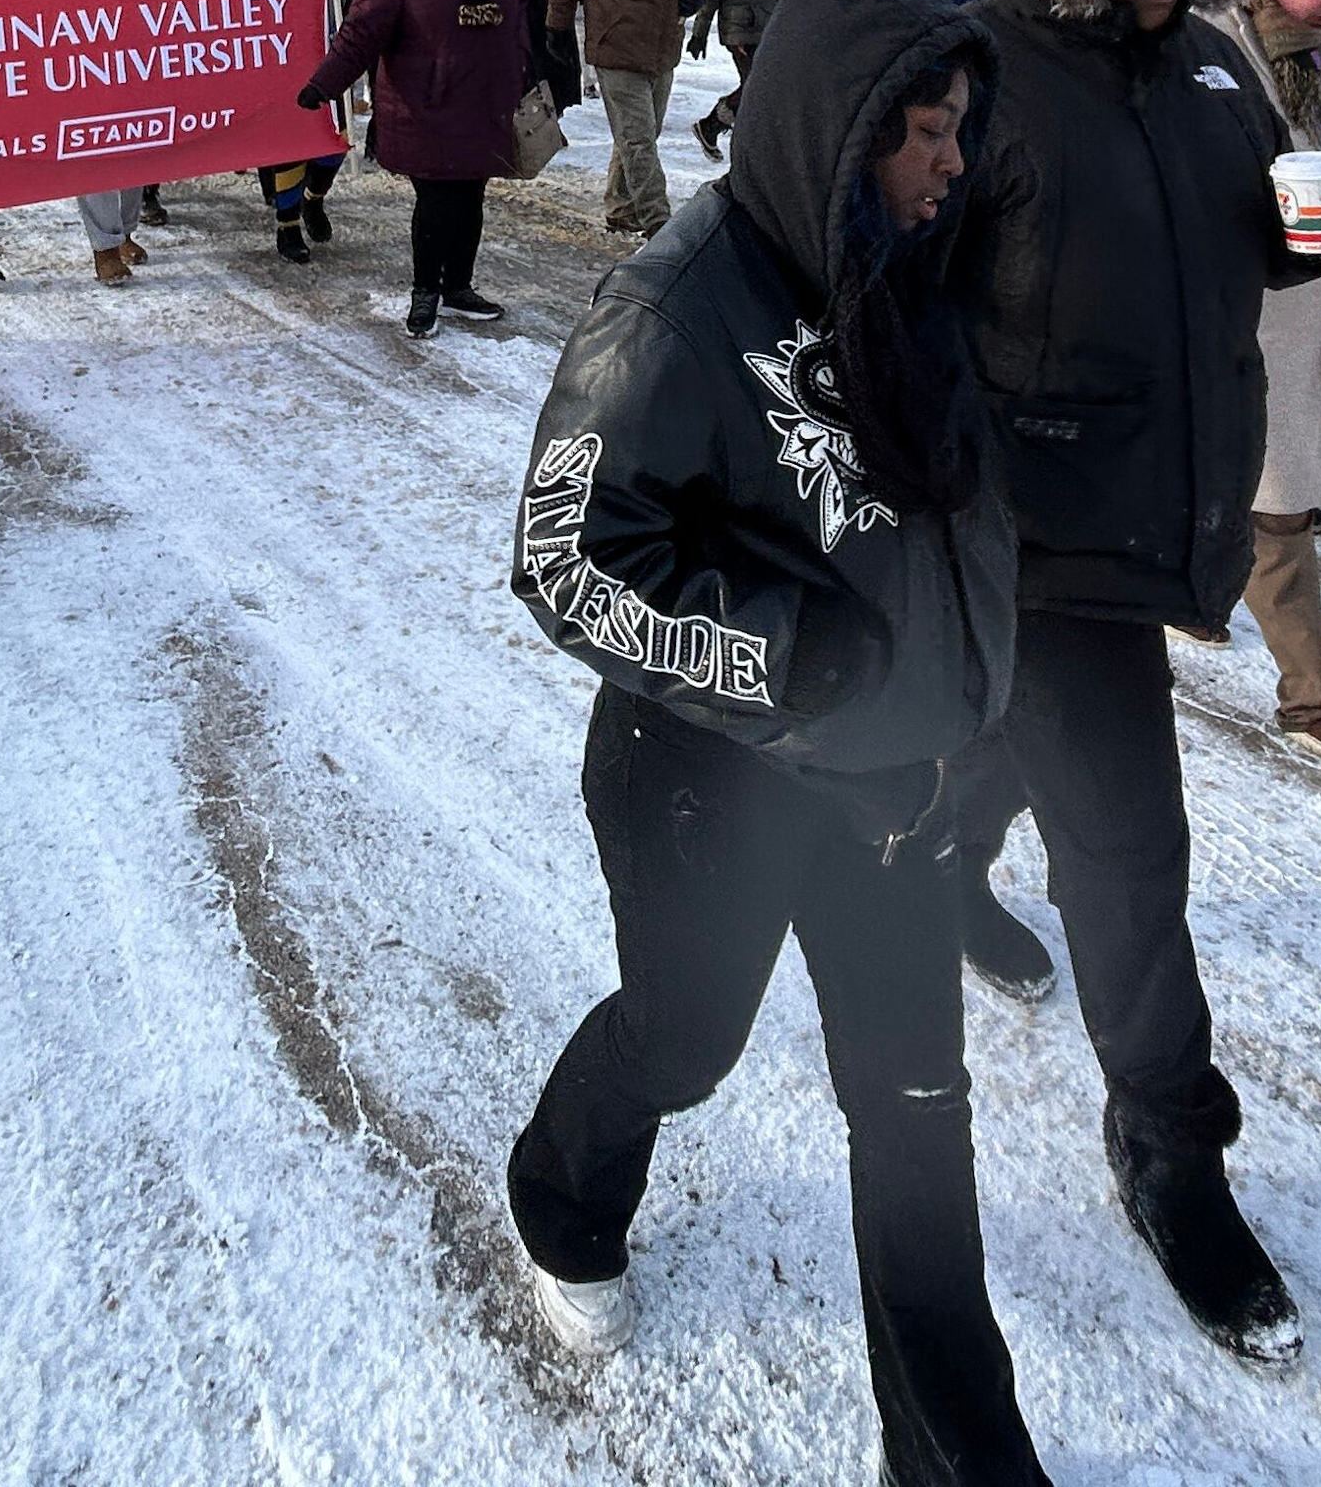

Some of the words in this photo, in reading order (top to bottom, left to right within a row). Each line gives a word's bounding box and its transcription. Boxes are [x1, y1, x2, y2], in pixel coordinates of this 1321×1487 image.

[43, 32, 293, 93] UNIVERSITY
[69, 118, 165, 148] STAND
[180, 108, 236, 133] OUT
